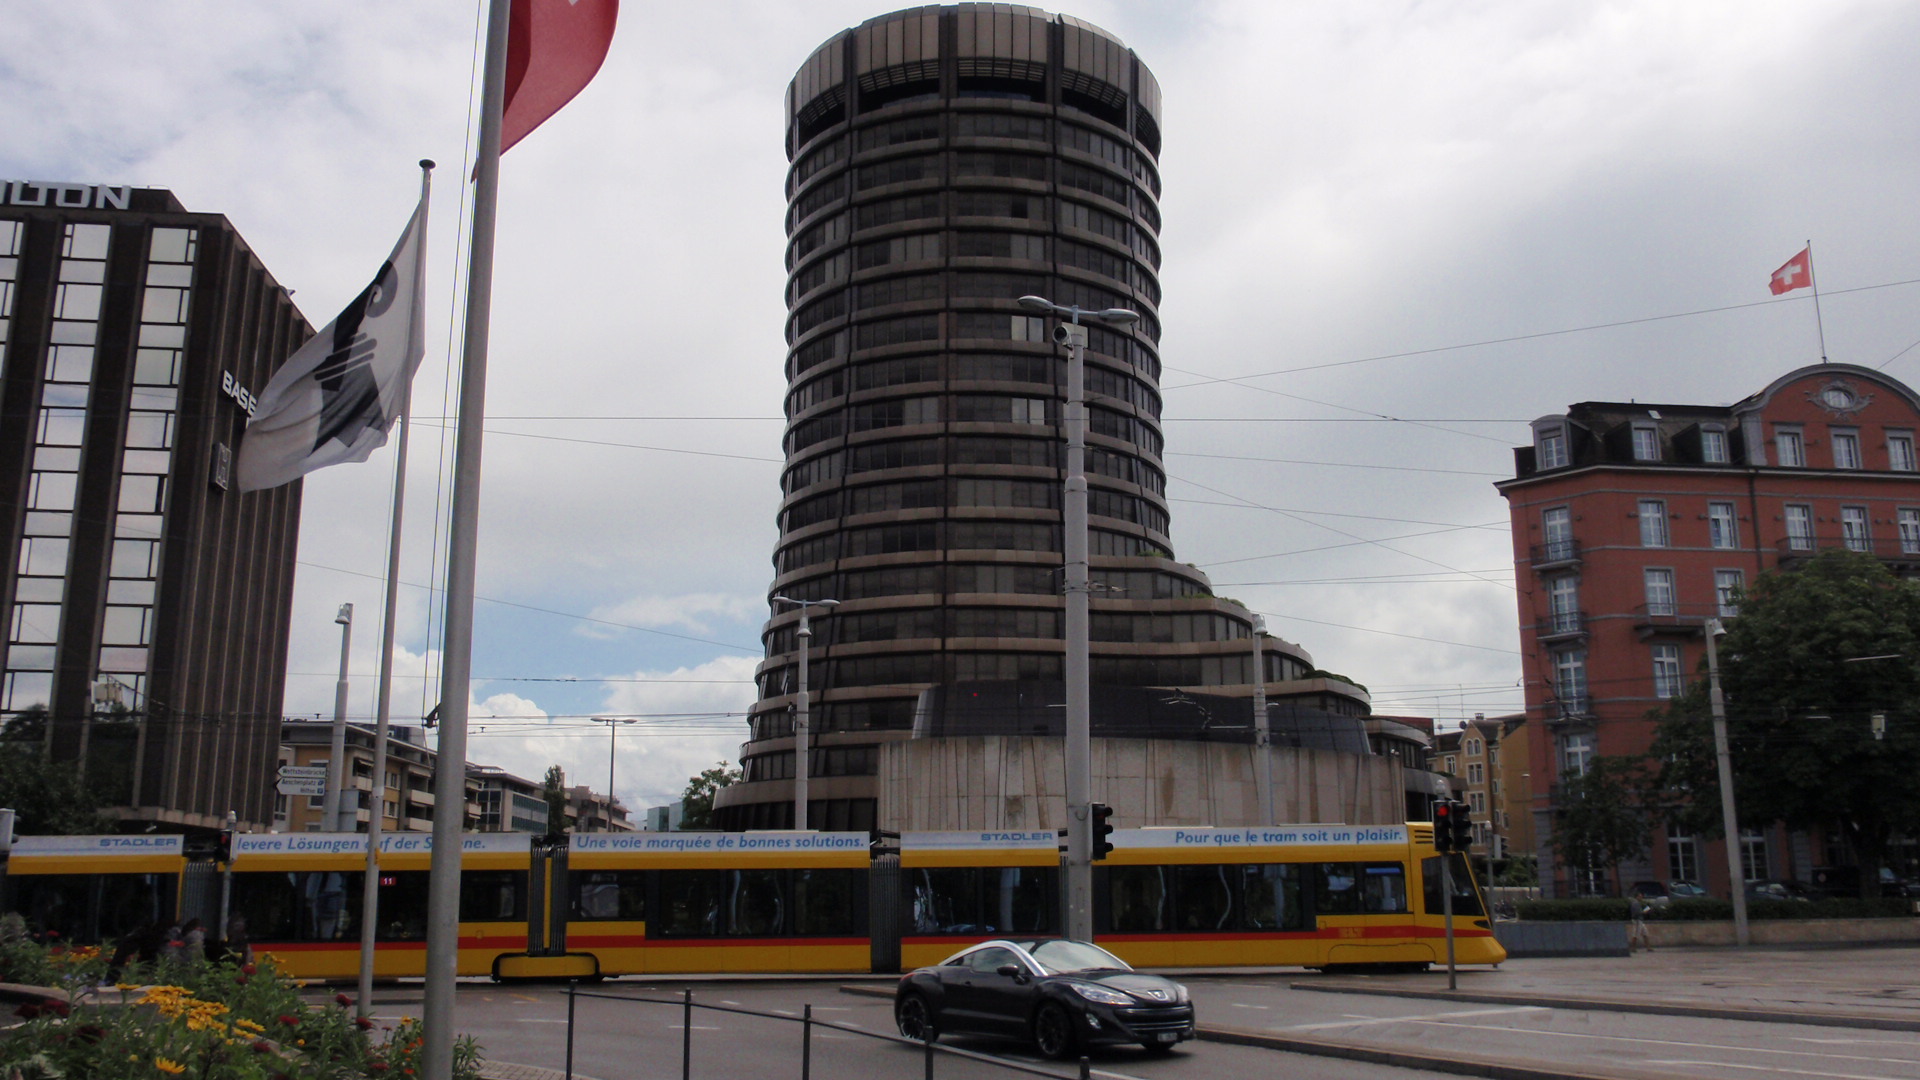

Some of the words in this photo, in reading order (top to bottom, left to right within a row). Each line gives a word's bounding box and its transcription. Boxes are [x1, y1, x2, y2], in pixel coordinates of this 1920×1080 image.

[222, 369, 258, 417] BASE
[100, 837, 178, 847] STADLER
[237, 838, 282, 850] levere
[288, 837, 359, 853] Lösungen
[395, 836, 420, 849] der
[577, 836, 607, 848] Une
[612, 836, 642, 848] voie
[647, 835, 711, 852] marquée
[716, 835, 734, 848] de
[739, 835, 791, 848] bonnes
[795, 835, 865, 848] solutions.
[980, 833, 1053, 841] STADLER
[1175, 831, 1209, 843] Pour
[1214, 833, 1240, 846] que
[1246, 831, 1258, 842] le
[1263, 831, 1297, 842] tram
[1302, 830, 1328, 842] soit
[1332, 832, 1350, 842] un
[1356, 829, 1402, 844] plaisir.
[384, 877, 392, 885] 11
